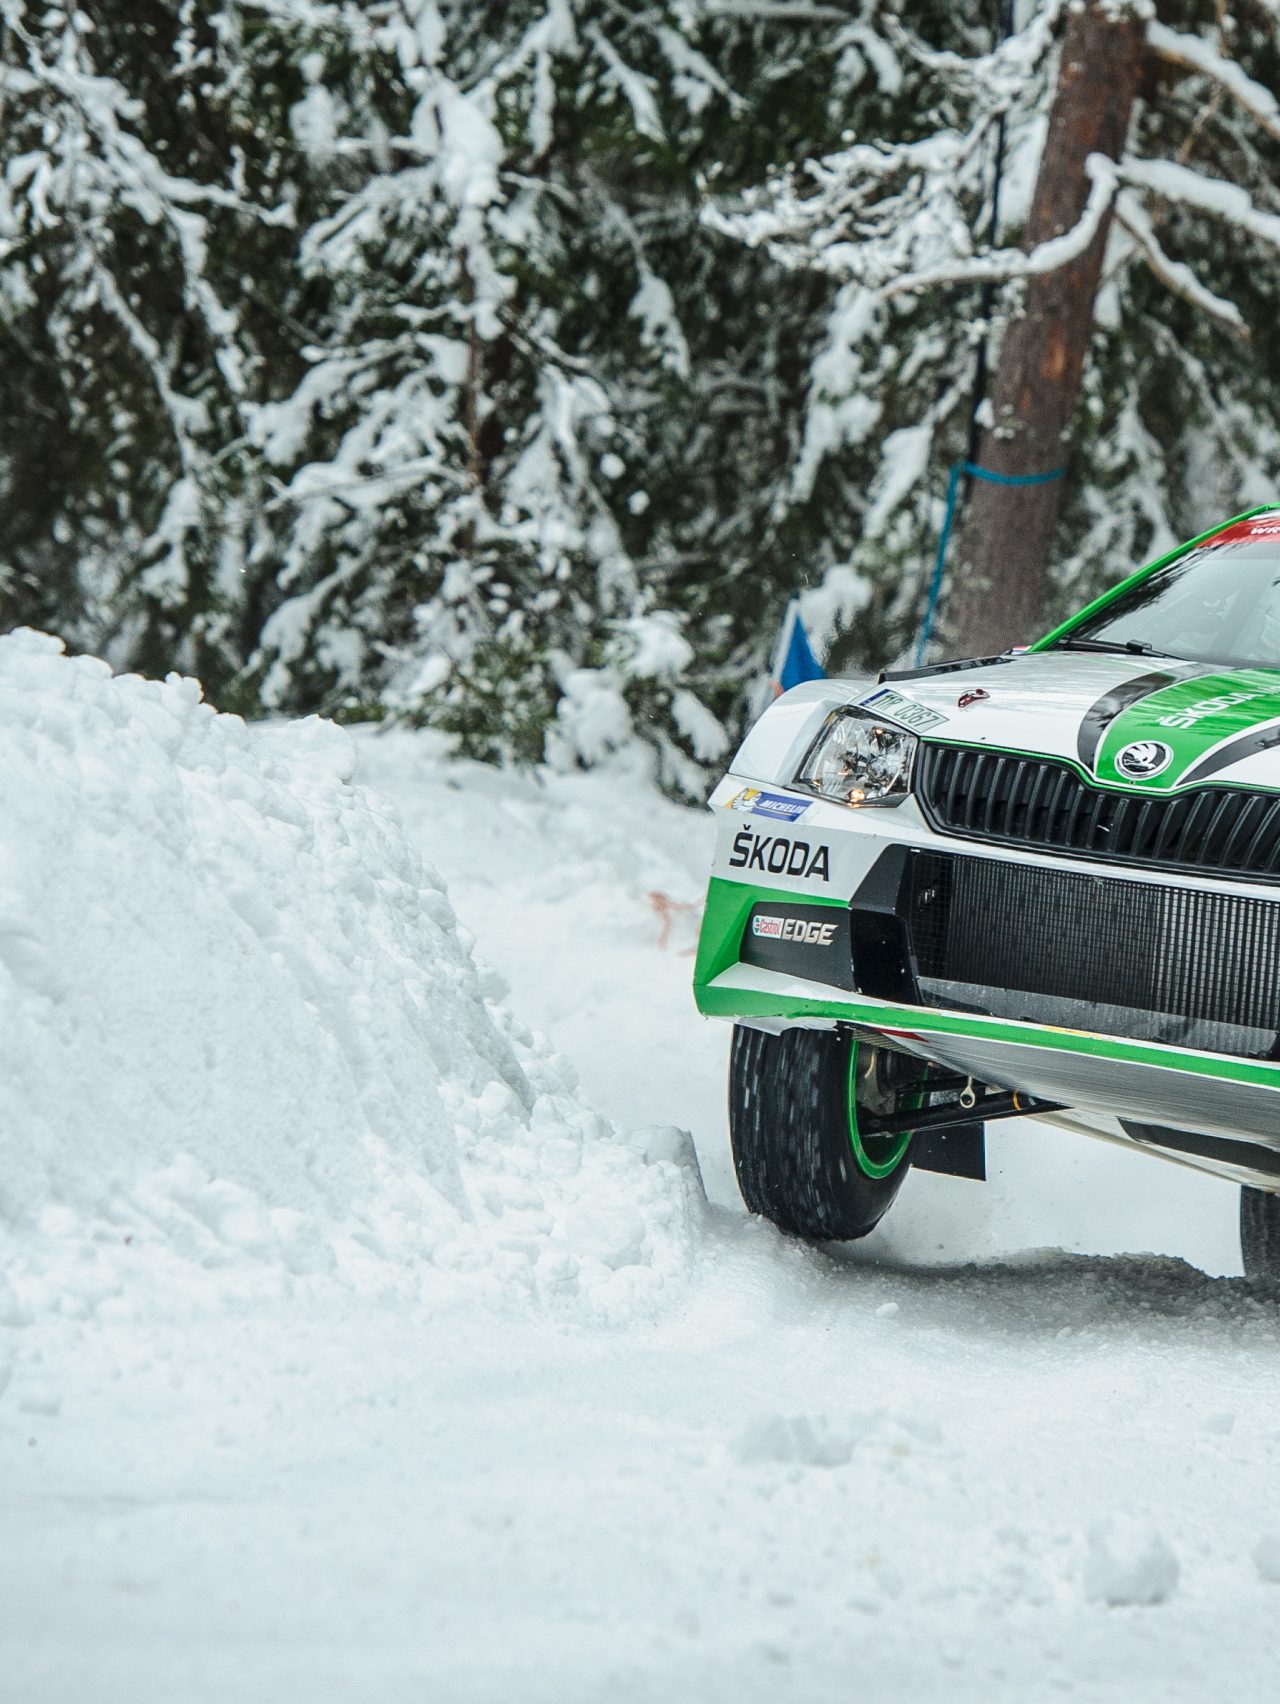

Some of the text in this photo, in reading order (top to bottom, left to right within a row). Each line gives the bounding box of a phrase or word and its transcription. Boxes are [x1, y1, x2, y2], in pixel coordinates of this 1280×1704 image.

[893, 704, 940, 727] 0367
[759, 799, 809, 815] MICHELIN
[728, 823, 830, 882] ŠKODA
[760, 918, 840, 946] Castrol EDGE
